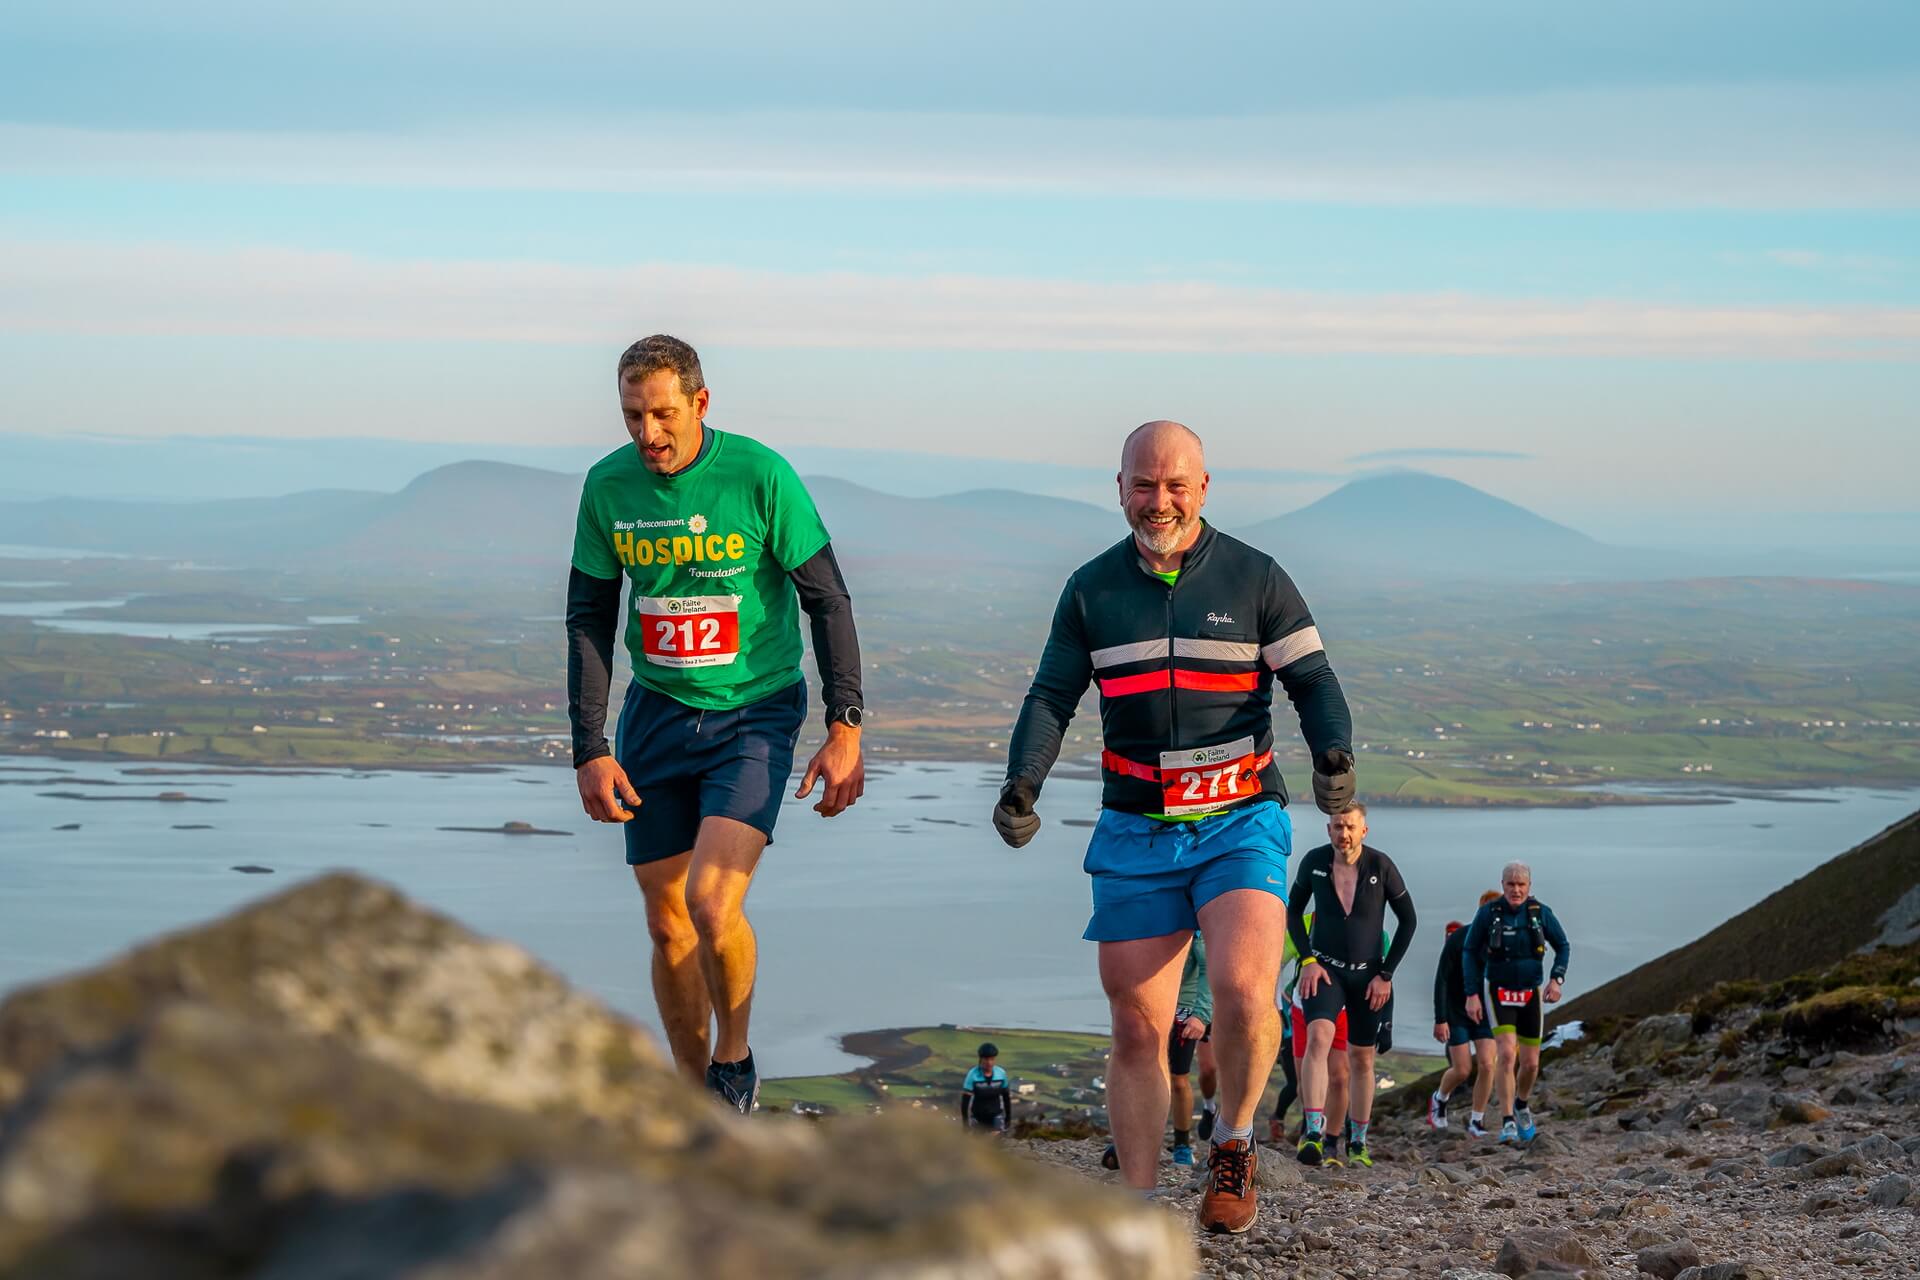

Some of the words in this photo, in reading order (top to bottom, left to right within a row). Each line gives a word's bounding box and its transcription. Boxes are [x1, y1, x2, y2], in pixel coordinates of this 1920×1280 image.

[614, 520, 635, 531] Mayo
[636, 518, 685, 529] Roscommon
[613, 531, 745, 566] Hospice
[689, 565, 746, 578] Foundation
[656, 618, 720, 651] 212
[1181, 763, 1240, 800] 277
[1503, 990, 1526, 1002] 111
